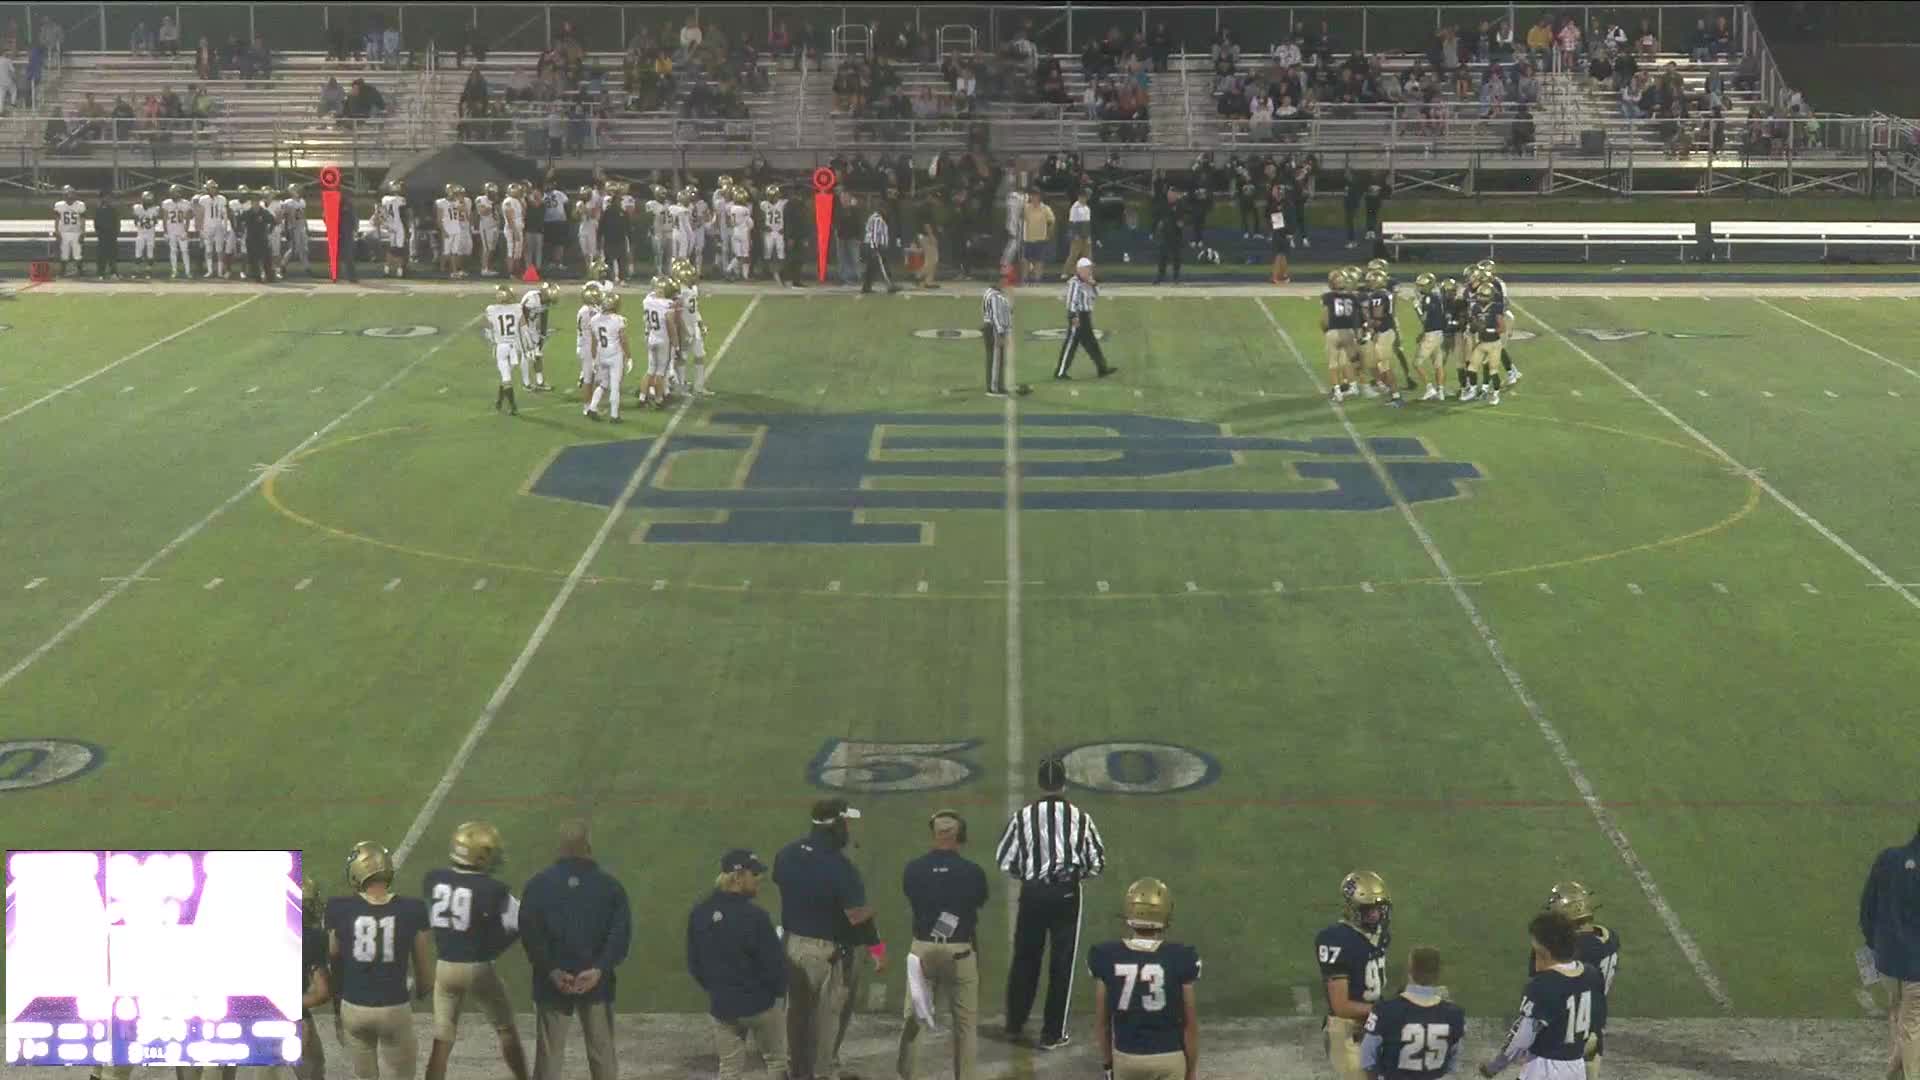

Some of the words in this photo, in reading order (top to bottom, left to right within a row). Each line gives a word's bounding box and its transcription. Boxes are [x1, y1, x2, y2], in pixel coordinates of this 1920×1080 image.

[62, 210, 79, 226] 65
[497, 313, 515, 337] 12
[598, 325, 609, 348] 6
[430, 883, 473, 932] 29
[352, 915, 396, 962] 81
[1318, 944, 1342, 964] 97
[1113, 963, 1167, 1011] 73
[1563, 990, 1592, 1043] 14
[1397, 1023, 1450, 1071] 25
